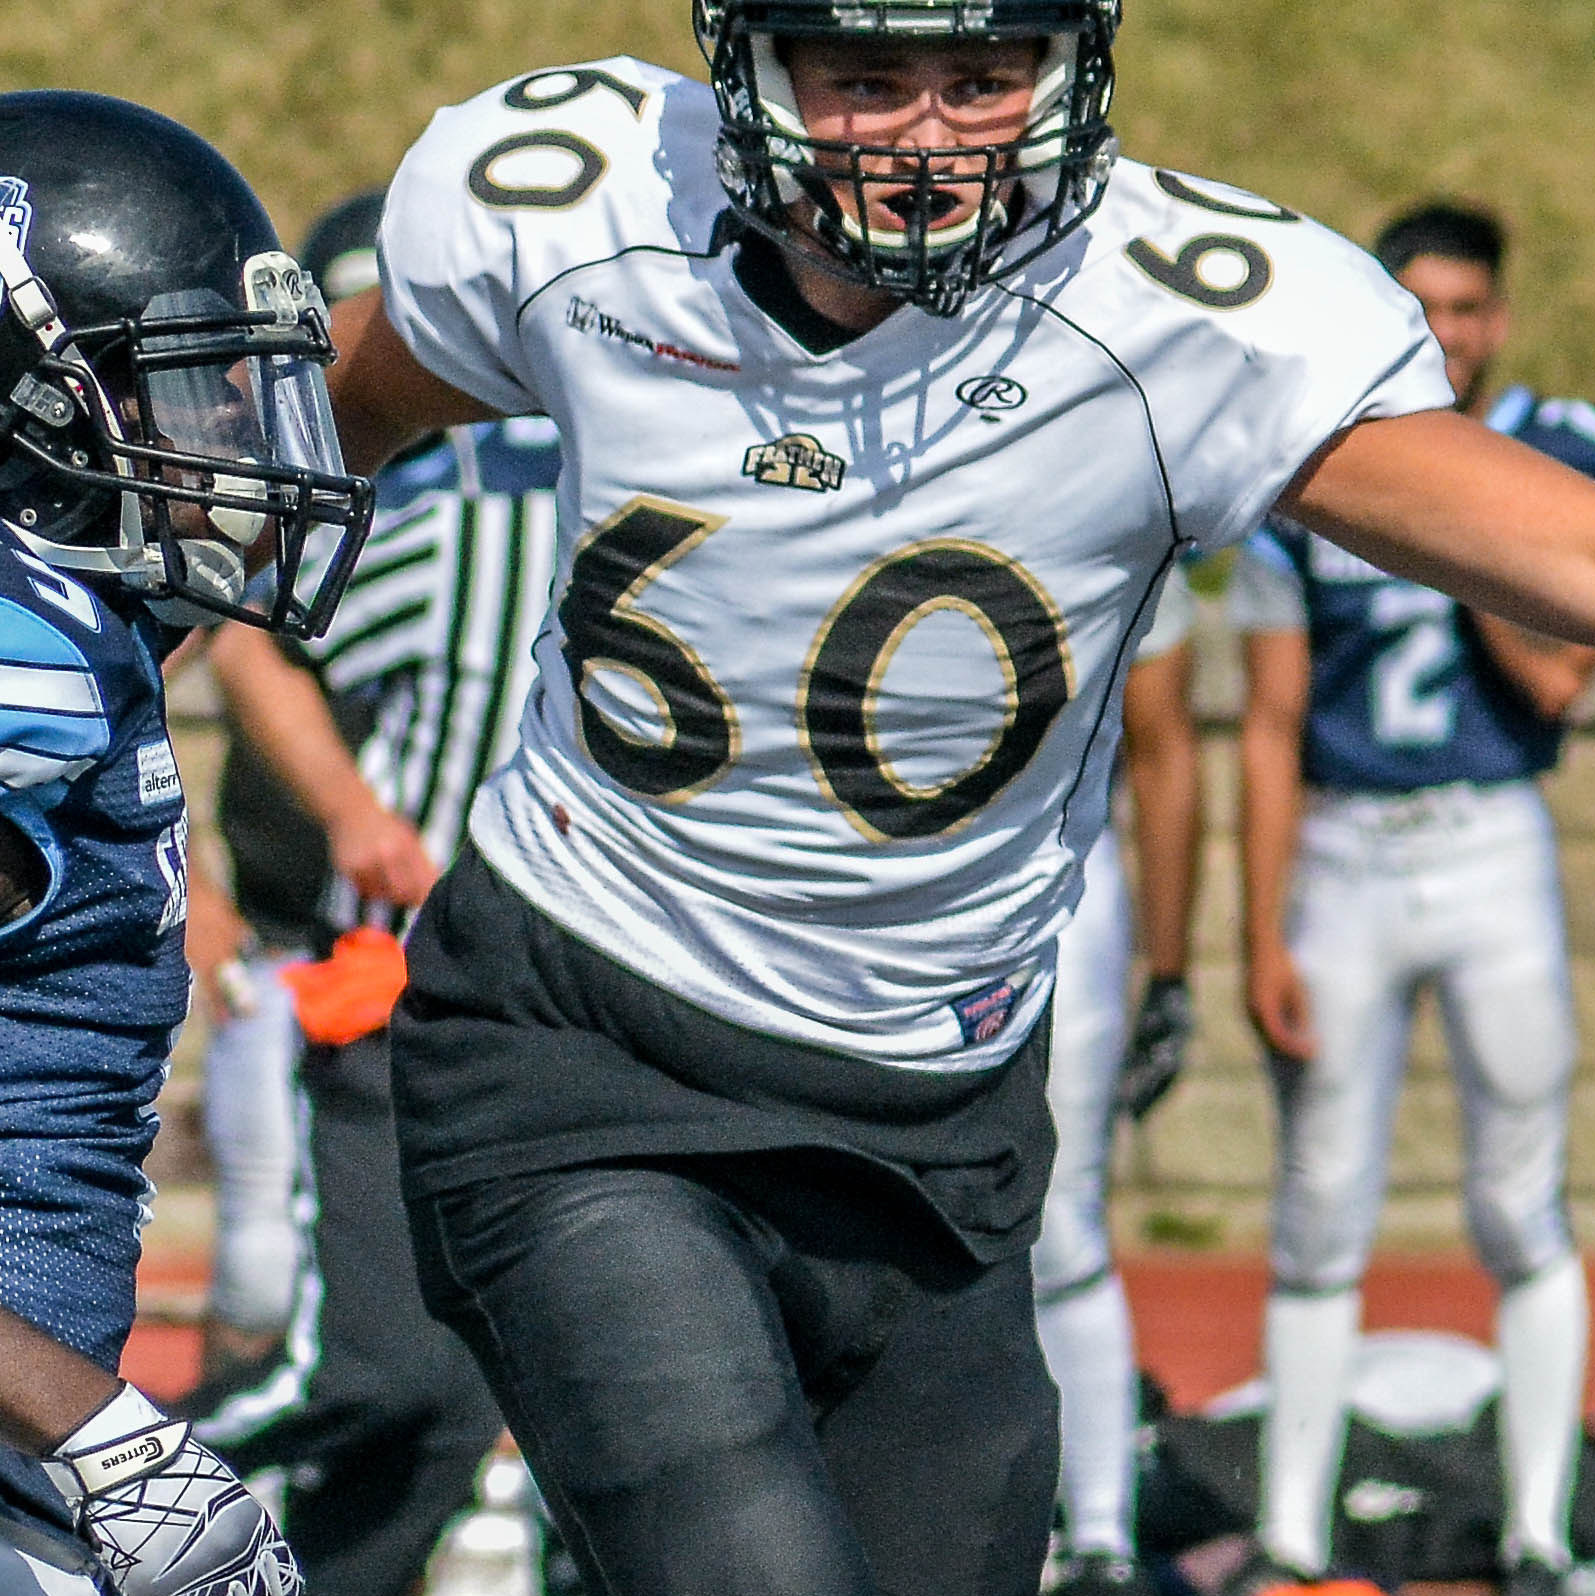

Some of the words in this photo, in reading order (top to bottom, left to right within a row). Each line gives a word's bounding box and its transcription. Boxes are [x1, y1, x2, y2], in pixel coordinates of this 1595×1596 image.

[466, 68, 648, 212] 60
[557, 494, 1077, 843] 60
[101, 1436, 164, 1471] CUTTERS
